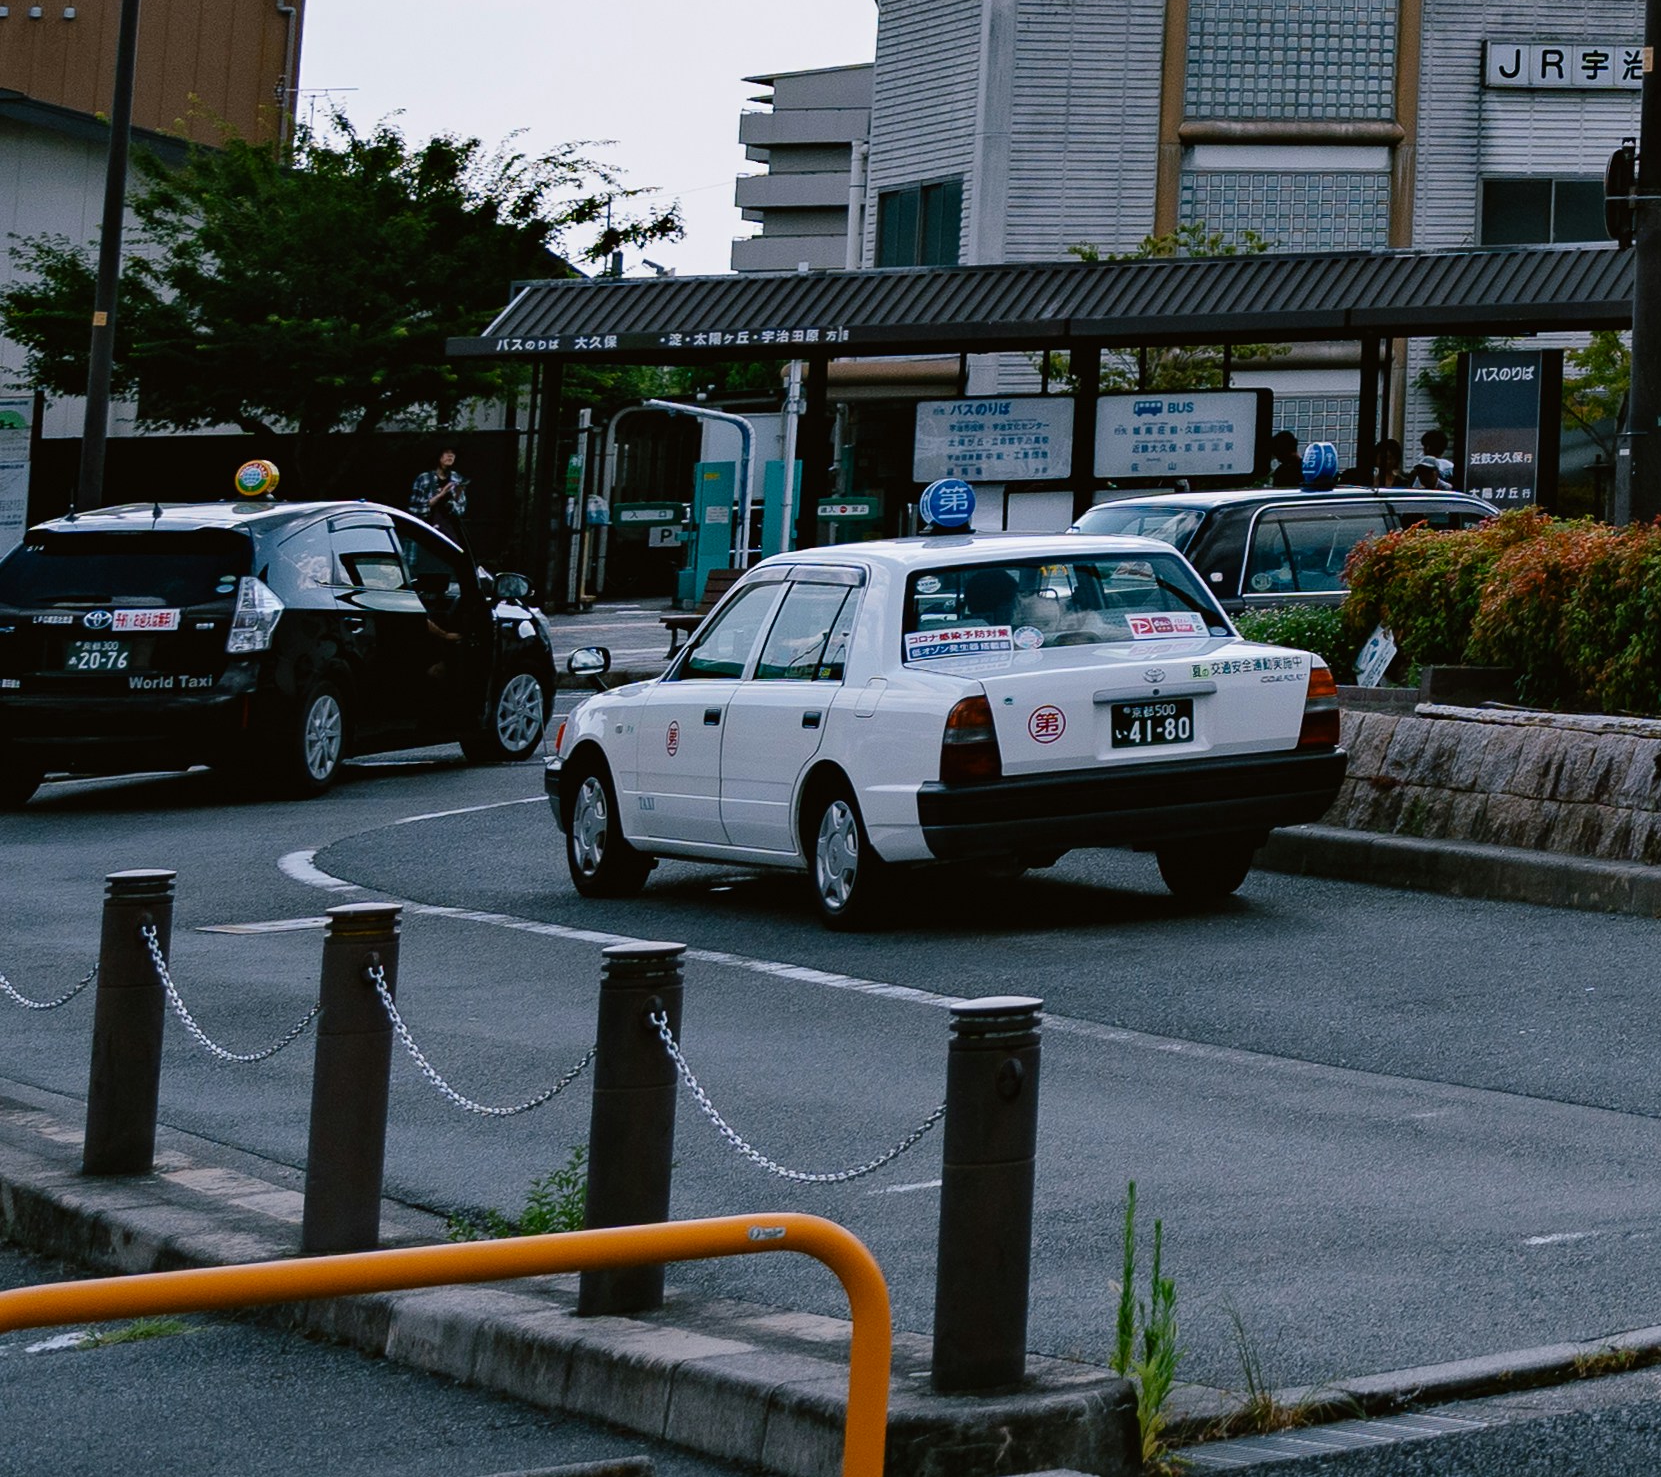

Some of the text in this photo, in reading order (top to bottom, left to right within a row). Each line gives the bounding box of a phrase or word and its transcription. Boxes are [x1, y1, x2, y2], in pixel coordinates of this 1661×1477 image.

[496, 338, 560, 351] バスのりば
[574, 335, 618, 350] 大久保
[1474, 365, 1536, 382] バスのりば
[950, 402, 1012, 415] バスのりば
[1167, 401, 1194, 413] BUS
[938, 485, 968, 519] 第一
[660, 529, 672, 543] P
[78, 652, 128, 669] 20-76
[129, 675, 213, 689] World Taxi
[1132, 704, 1176, 719] 京都500
[1035, 713, 1059, 737] 第一
[1116, 717, 1190, 743] い 41-80
